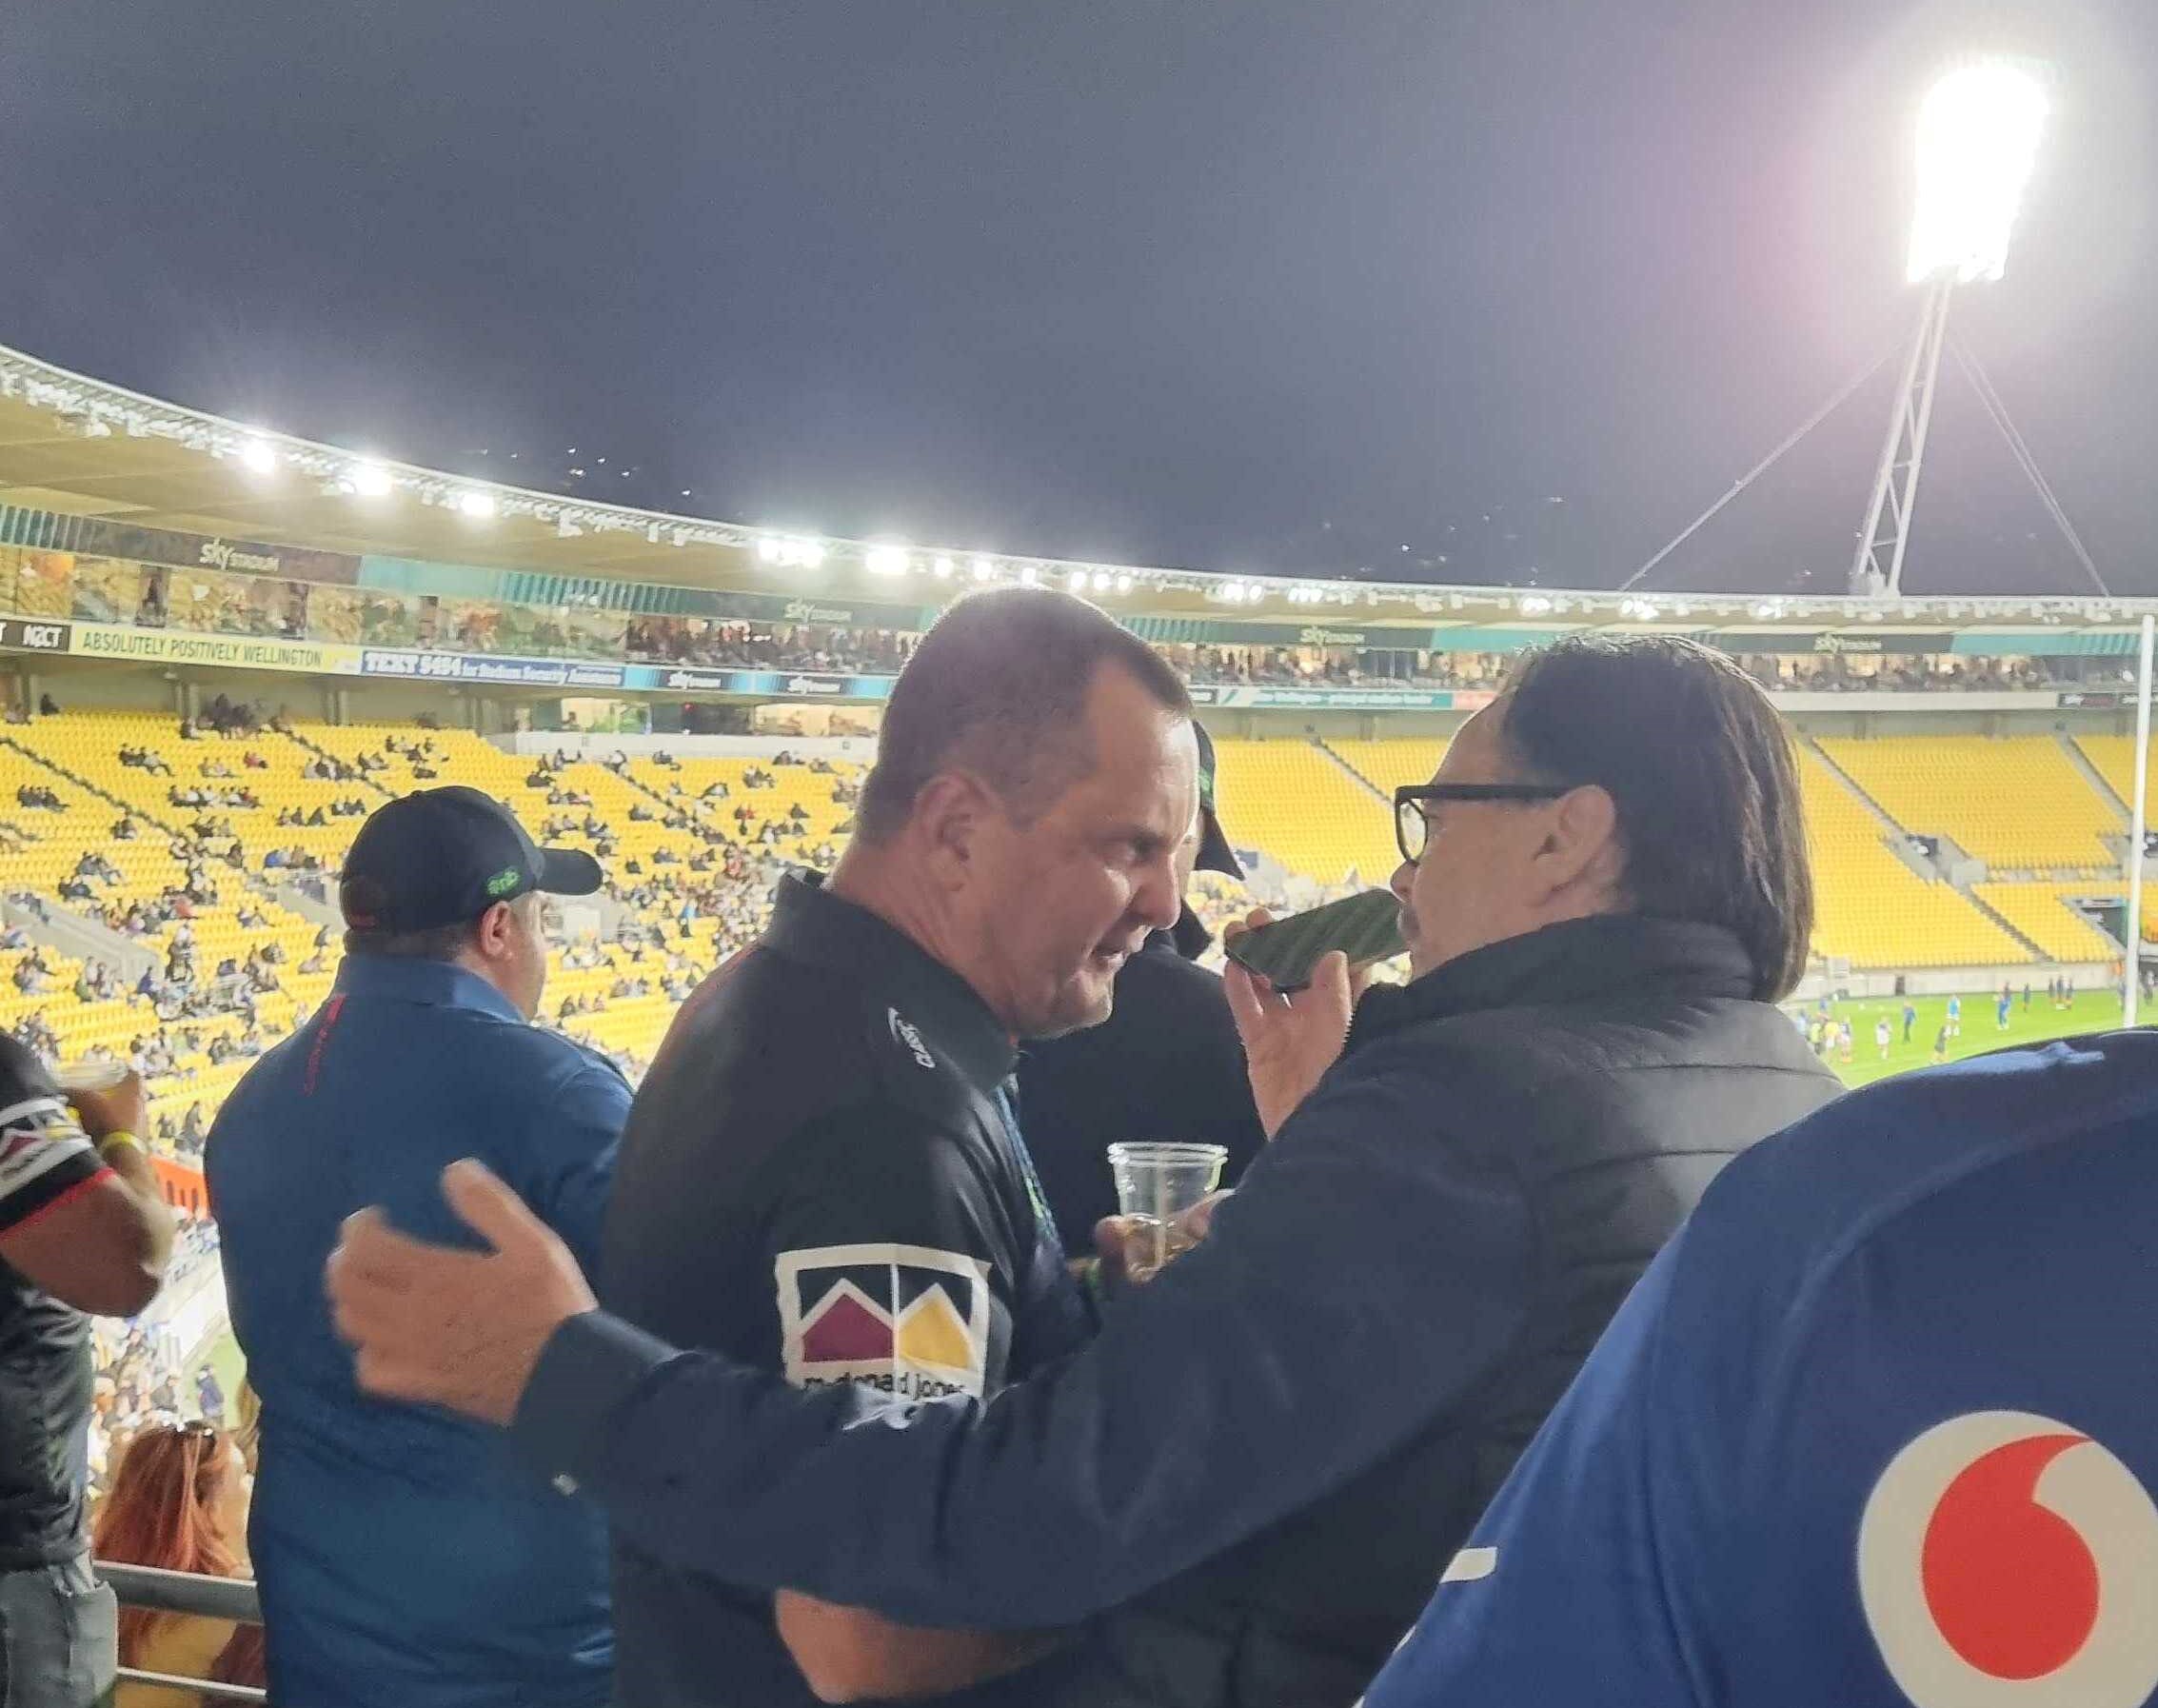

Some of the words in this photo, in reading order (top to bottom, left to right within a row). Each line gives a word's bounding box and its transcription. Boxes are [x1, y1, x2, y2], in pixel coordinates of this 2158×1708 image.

[84, 631, 166, 655] ABSOLUTELY
[170, 639, 240, 662] POSITIVELY
[244, 645, 323, 667] WELLINGTON
